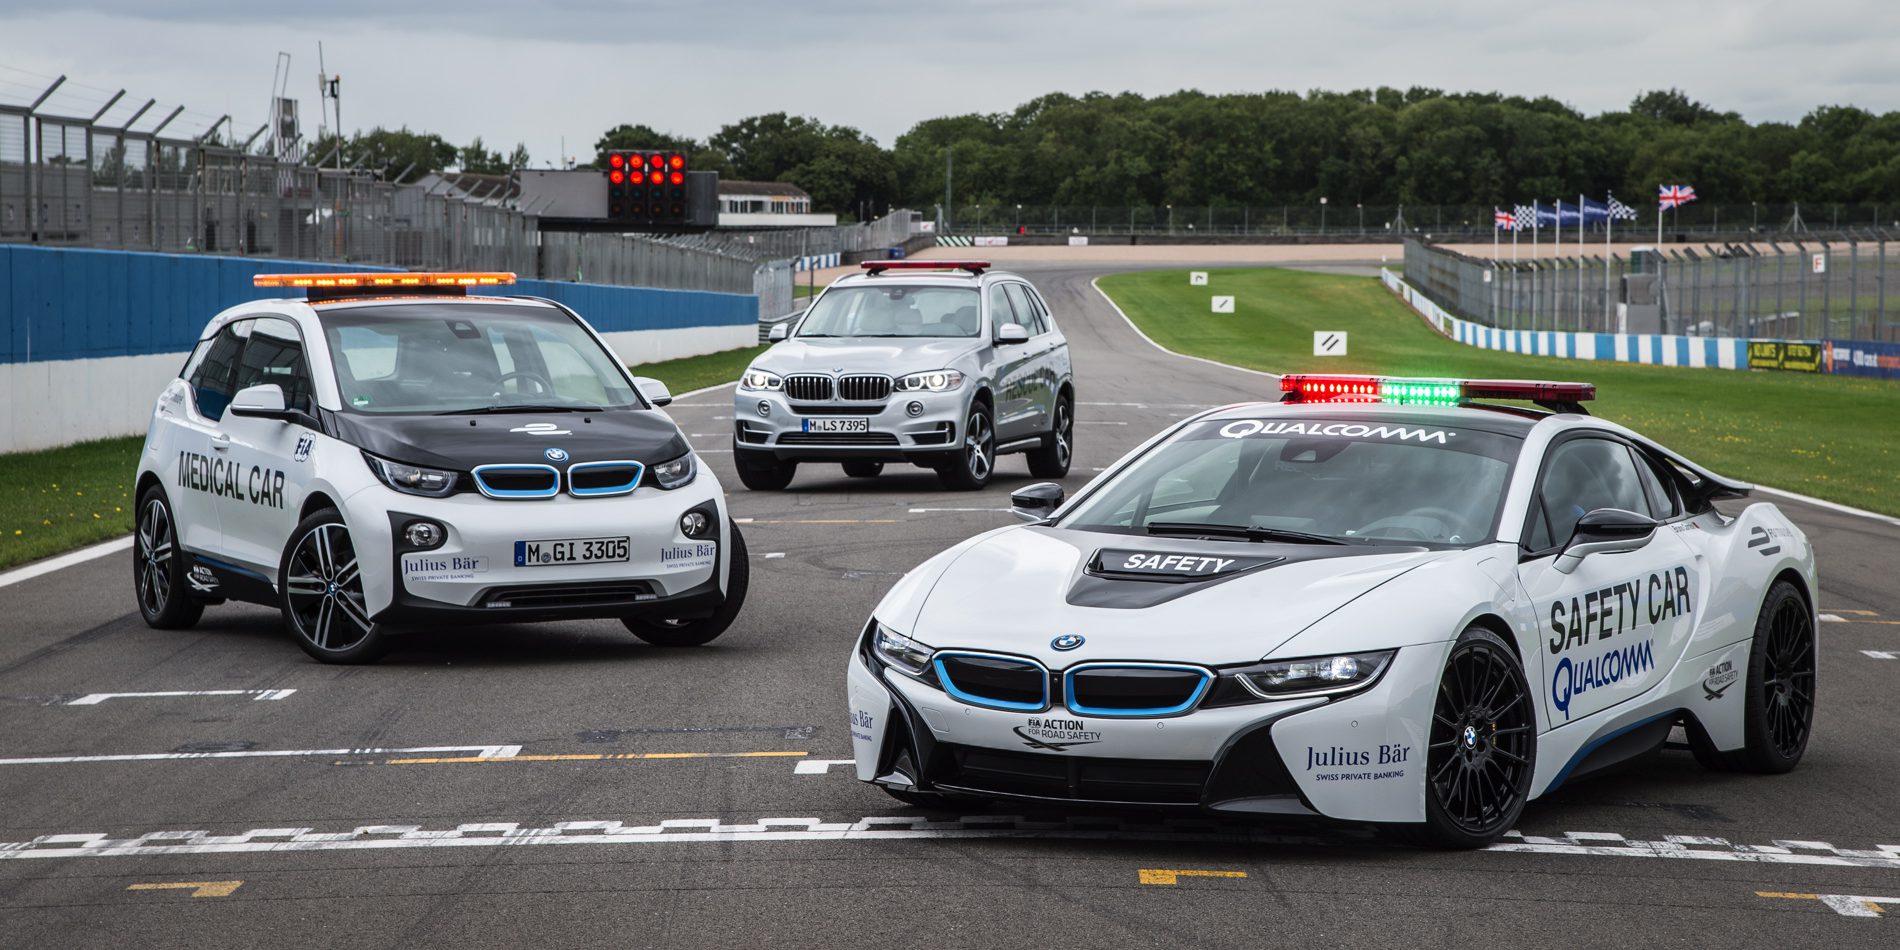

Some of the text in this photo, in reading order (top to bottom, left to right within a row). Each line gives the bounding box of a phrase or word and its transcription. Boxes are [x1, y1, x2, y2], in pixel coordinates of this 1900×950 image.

[810, 421, 866, 431] M LS 7395
[1220, 419, 1447, 444] QUALCOMM
[178, 451, 285, 509] MEDICAL CAR
[528, 539, 628, 563] M GI 3305
[661, 544, 715, 563] Julius Bär
[405, 557, 479, 575] Julius Bär
[1123, 553, 1235, 573] SAFETY
[1550, 566, 1691, 655] SAFETY CAR
[1552, 639, 1654, 720] QUALCOMM
[859, 710, 873, 729] Bär
[1044, 719, 1084, 731] ACTION
[1028, 728, 1101, 741] FOR ROAD SAFETY
[1306, 744, 1410, 771] Julius Bär
[1316, 770, 1404, 781] SWISS PRIVATE BANKING
